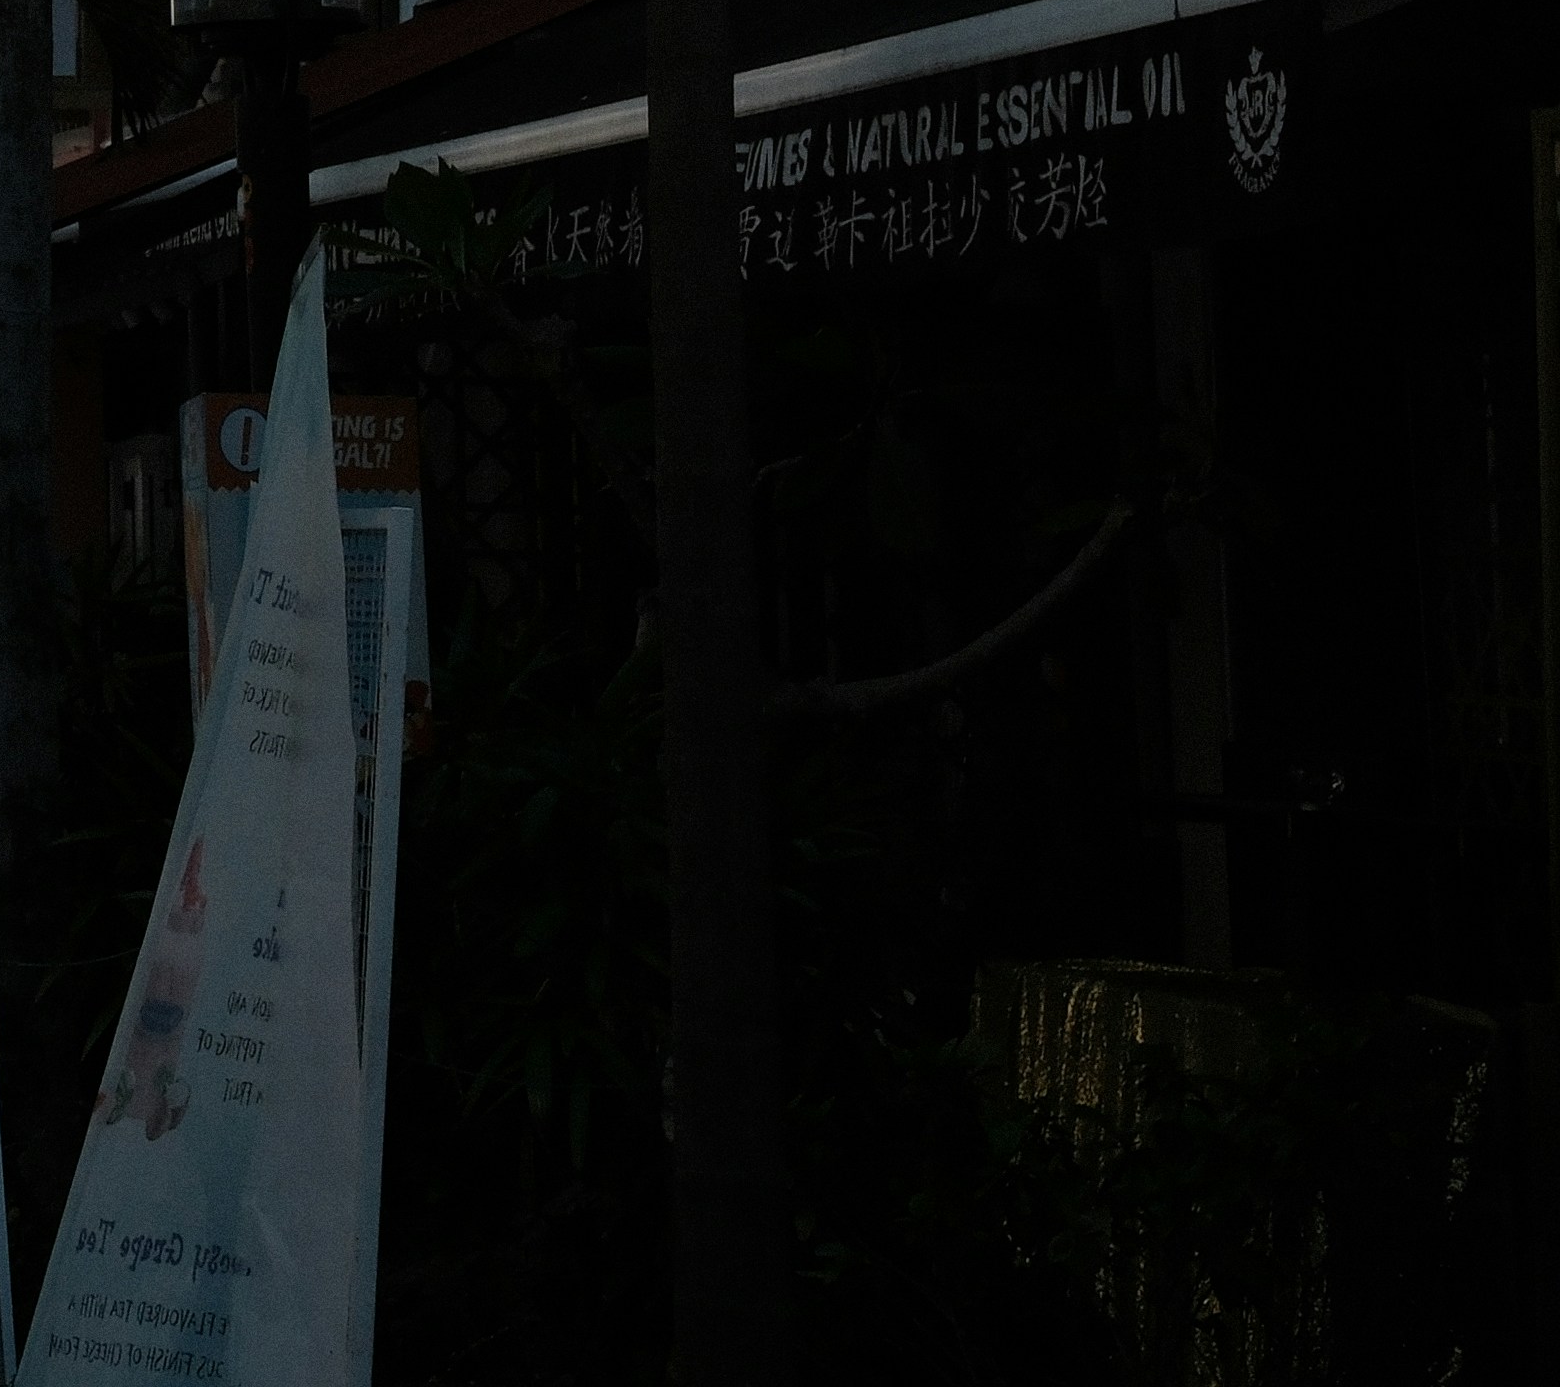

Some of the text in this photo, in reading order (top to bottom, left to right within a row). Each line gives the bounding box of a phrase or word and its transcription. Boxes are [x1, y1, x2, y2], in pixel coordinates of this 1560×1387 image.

[845, 101, 965, 174] NATURAL
[977, 65, 1133, 151] ESSENTIAL
[385, 415, 405, 442] IS
